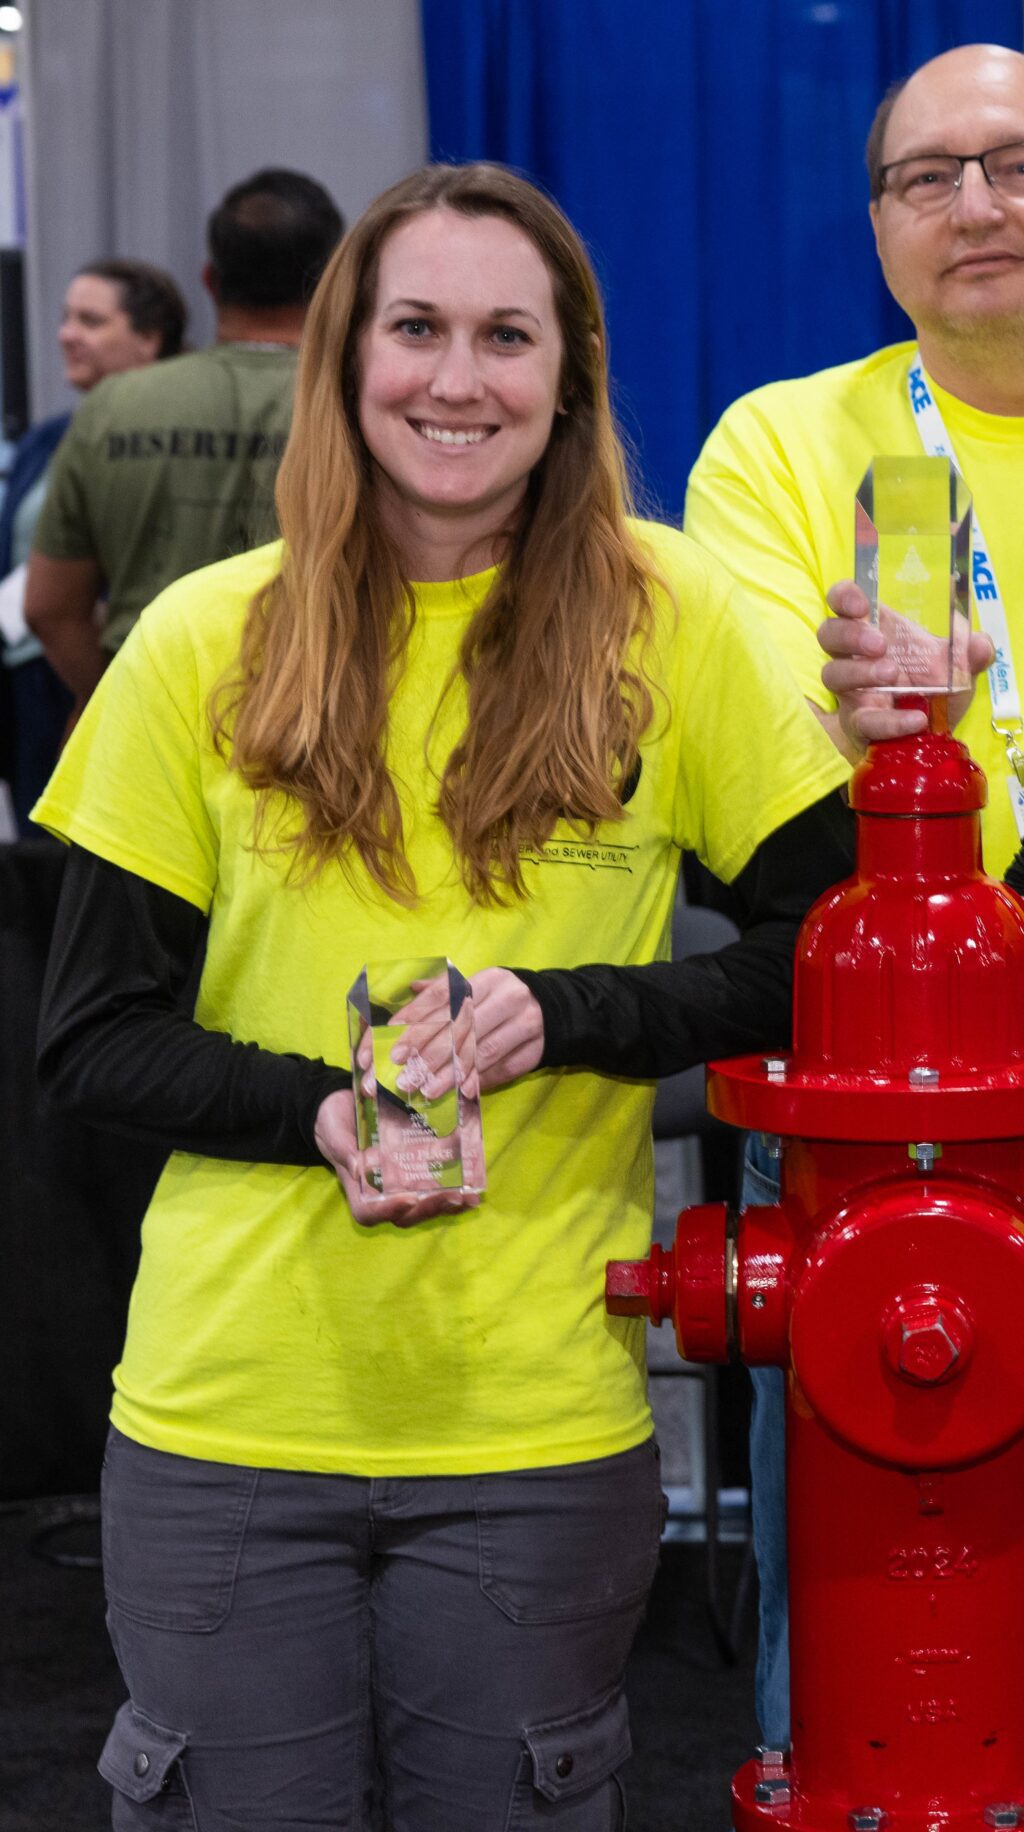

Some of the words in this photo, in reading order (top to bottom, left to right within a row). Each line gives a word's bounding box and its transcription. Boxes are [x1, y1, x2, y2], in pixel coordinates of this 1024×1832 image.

[909, 367, 932, 414] ACE
[108, 428, 239, 462] DESERT
[972, 550, 998, 601] ACE
[562, 847, 599, 859] SEWER
[601, 851, 628, 863] UTILITY
